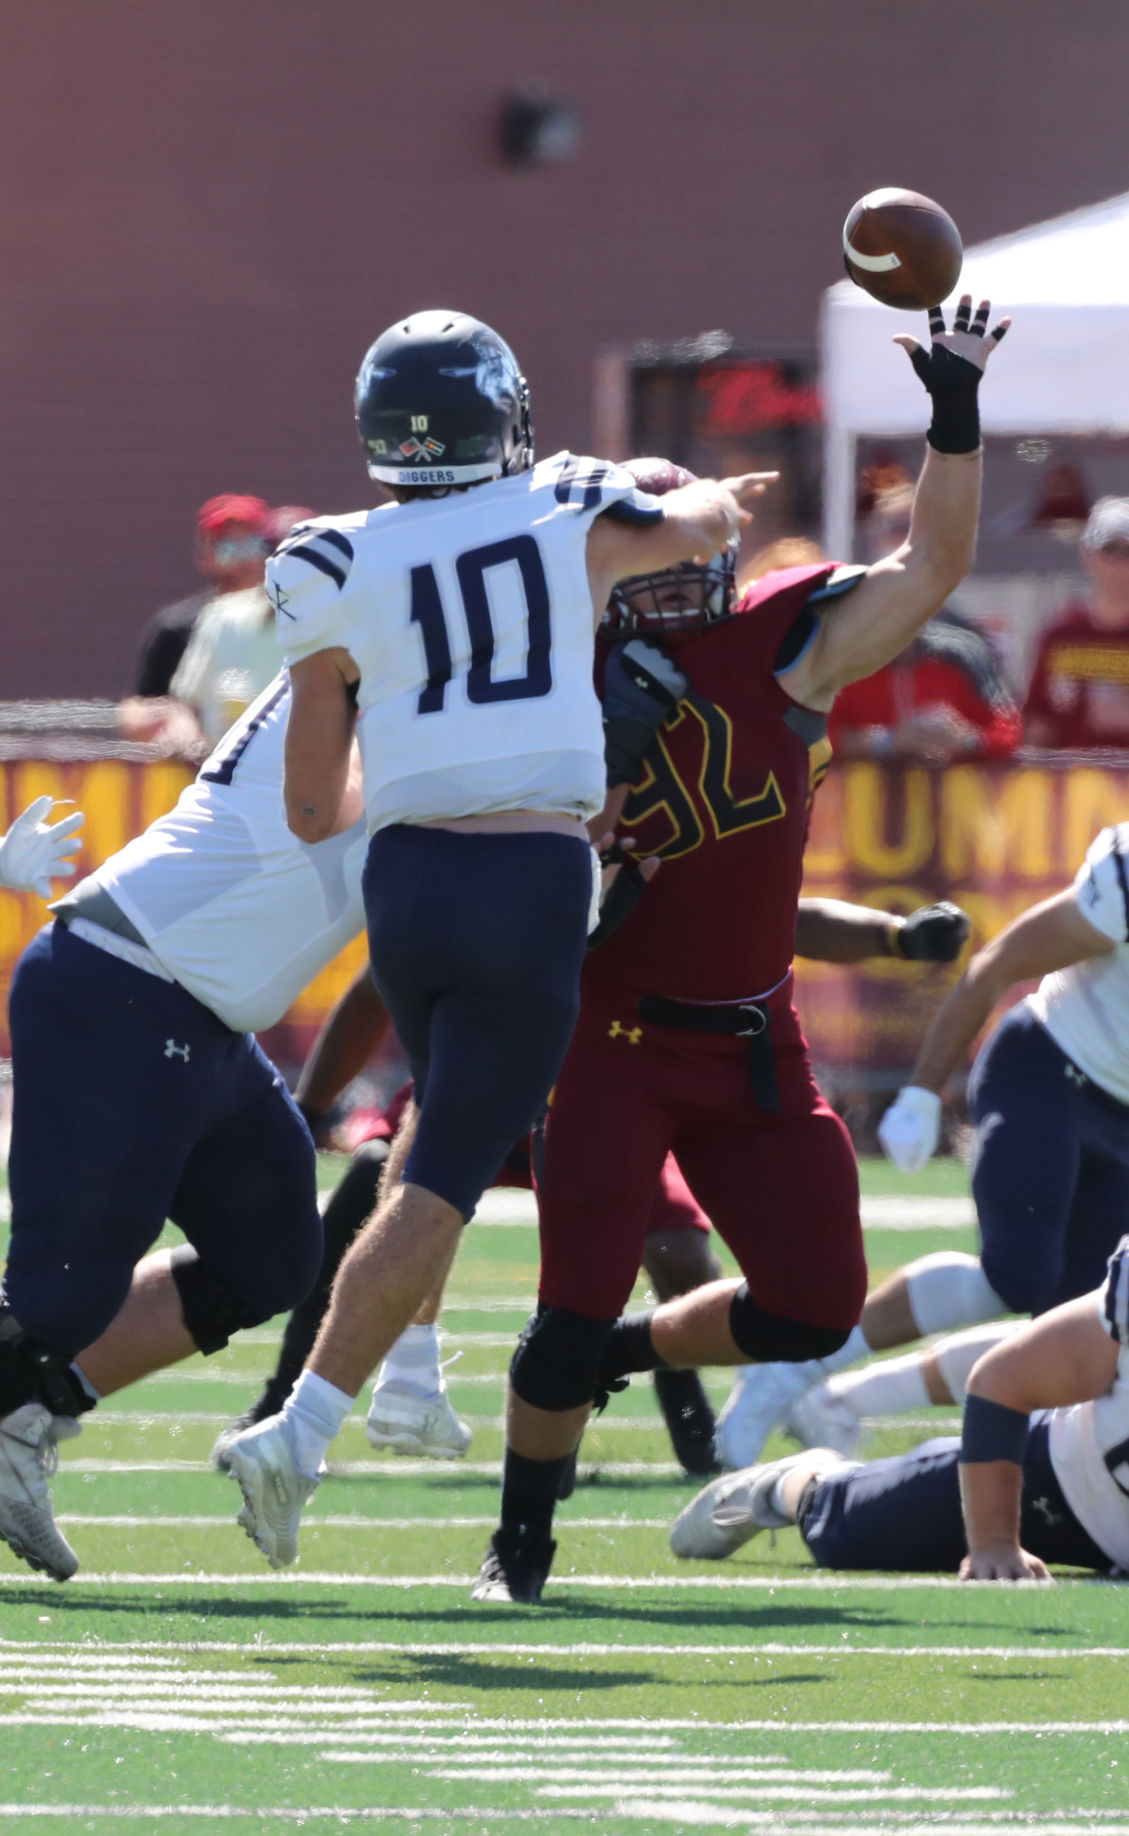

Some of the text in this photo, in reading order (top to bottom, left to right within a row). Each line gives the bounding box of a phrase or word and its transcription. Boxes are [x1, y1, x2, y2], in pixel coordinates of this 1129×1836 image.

[410, 415, 428, 433] 10
[398, 470, 455, 482] DIGGERS
[410, 534, 552, 715] 10
